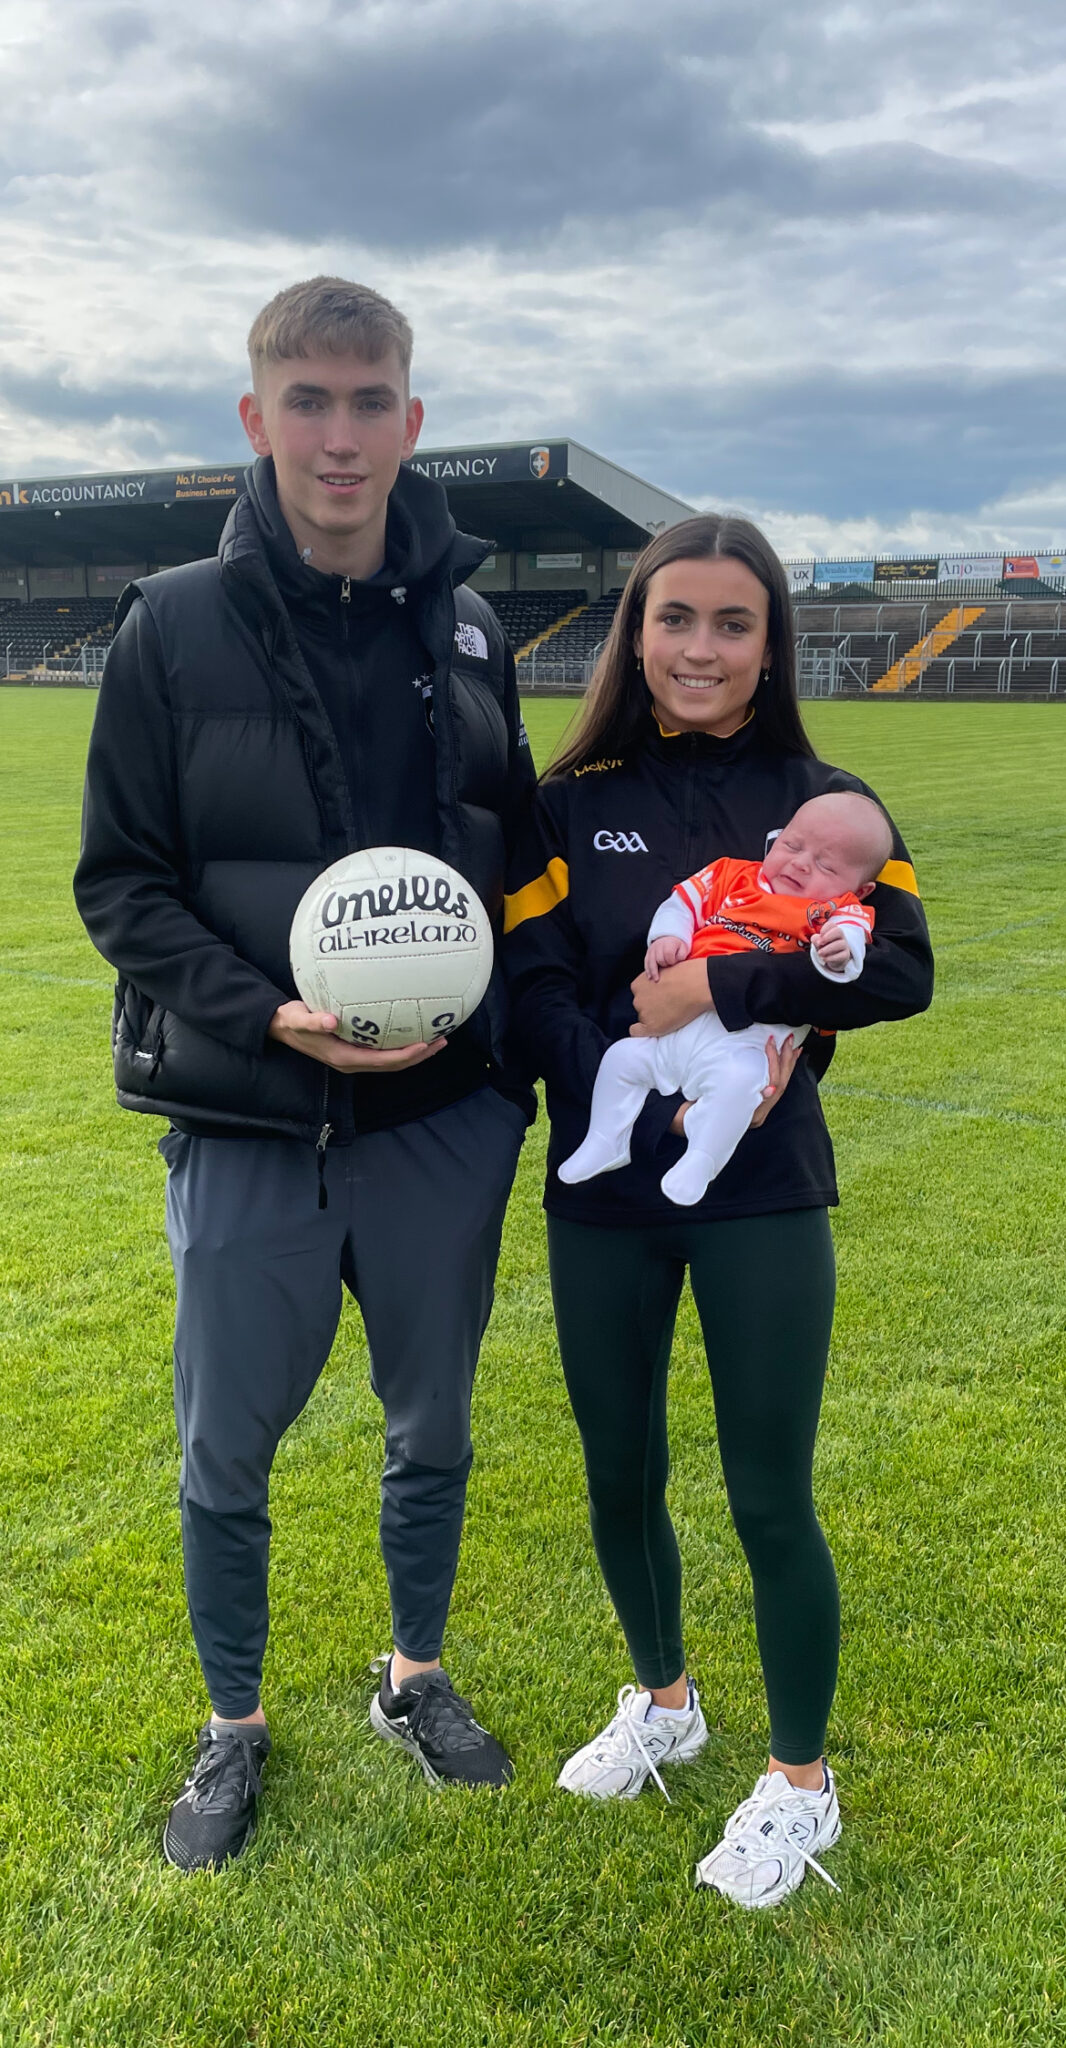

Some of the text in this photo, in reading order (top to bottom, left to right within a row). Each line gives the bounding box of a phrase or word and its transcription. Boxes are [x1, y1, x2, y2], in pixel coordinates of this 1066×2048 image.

[176, 473, 236, 485] No.1 Choice For
[31, 481, 146, 504] ACCOUNTANCY
[175, 487, 236, 498] Business Owners
[793, 570, 810, 580] UX
[939, 561, 973, 577] Anjo
[457, 622, 474, 635] THE
[454, 630, 475, 646] ORTH
[458, 643, 477, 657] FACE
[593, 830, 649, 853] GAA
